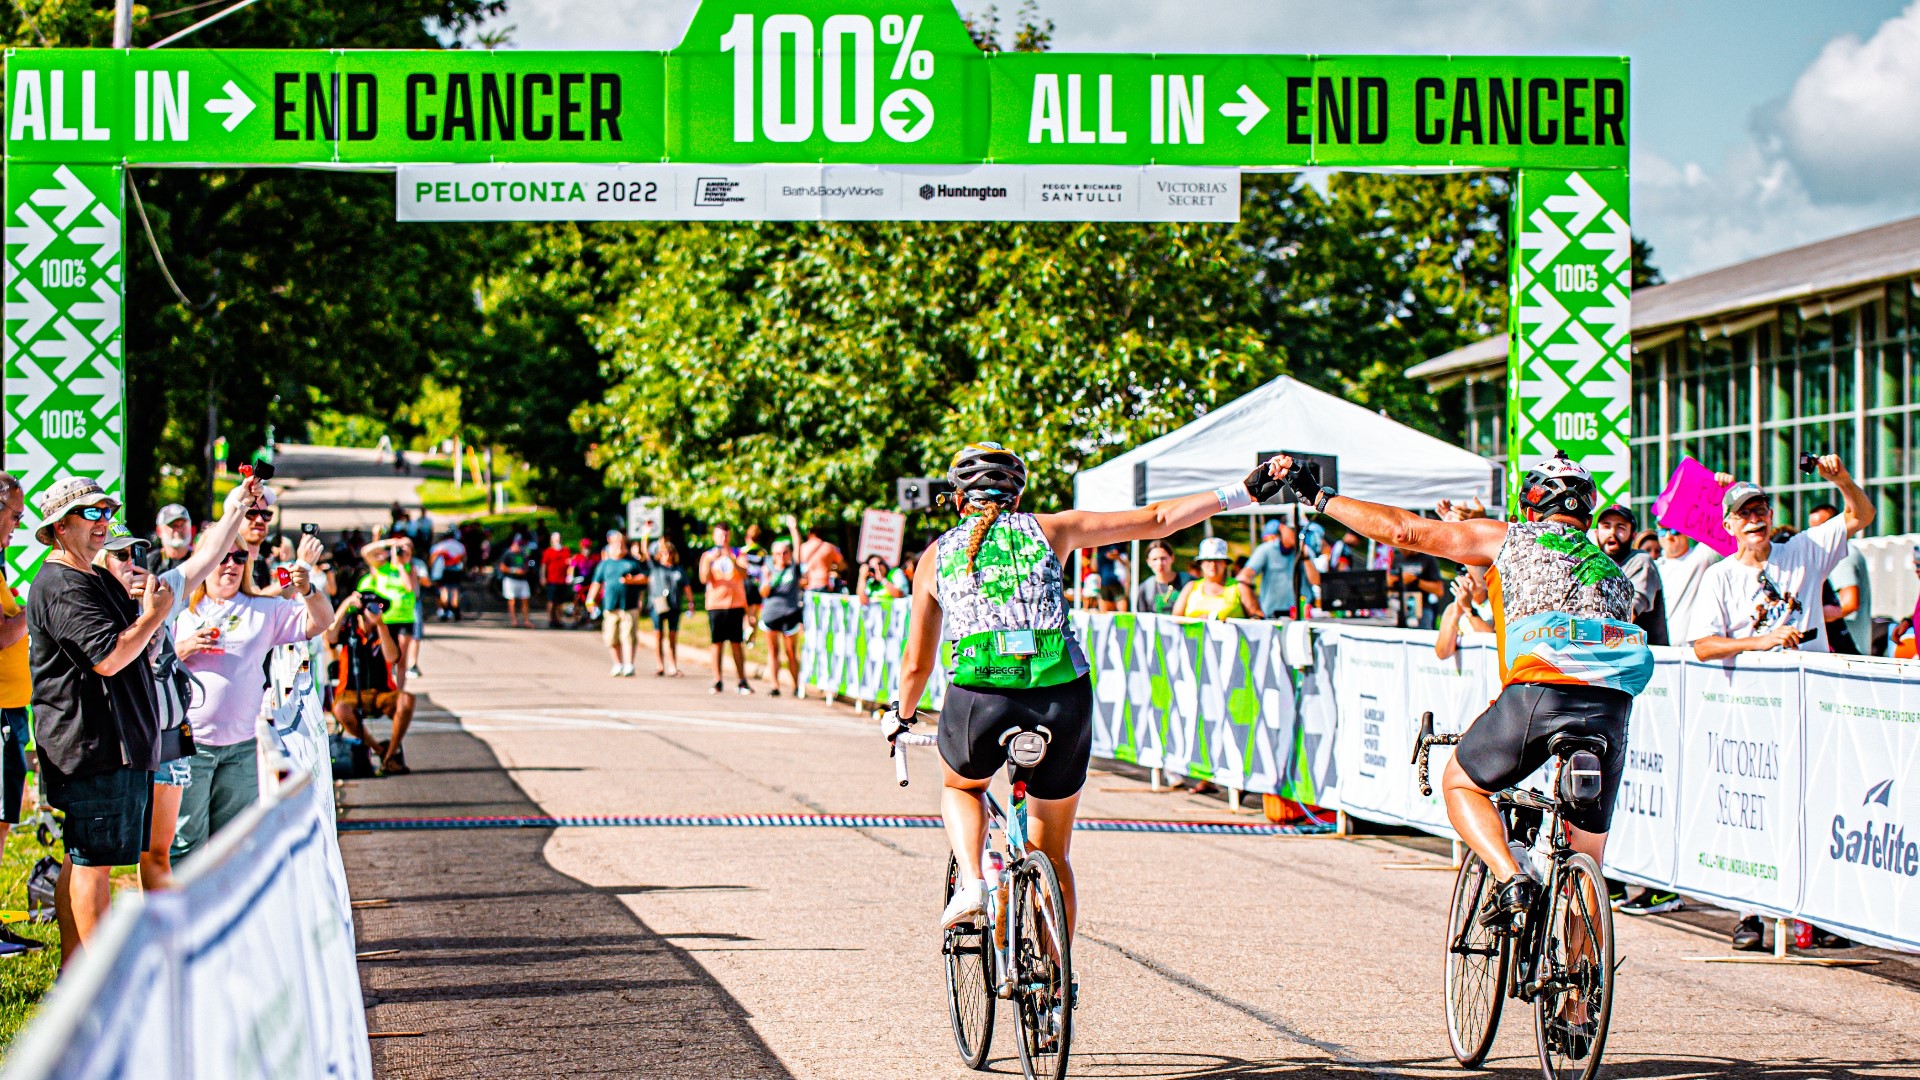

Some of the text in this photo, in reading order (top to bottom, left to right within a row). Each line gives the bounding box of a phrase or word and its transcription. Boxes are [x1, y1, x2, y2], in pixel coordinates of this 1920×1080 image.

[720, 14, 935, 143] 100%
[10, 69, 623, 142] ALL IN END CANCER
[1028, 73, 1626, 146] ALL IN END CANCER
[415, 181, 658, 202] PELOTONIA 2022
[937, 183, 1007, 201] Huntington
[1042, 192, 1122, 202] SANTULLI
[1157, 181, 1228, 193] VICTORIA'S
[1168, 195, 1216, 206] SECRET
[39, 259, 87, 288] 100%
[1553, 263, 1599, 293] 100%
[39, 409, 87, 439] 100%
[1553, 411, 1599, 441] 100%
[1522, 625, 1567, 642] one
[974, 666, 1025, 675] HABEGGER
[1708, 731, 1779, 781] VICTORIA'S
[1716, 783, 1766, 831] SECRET
[1830, 814, 1919, 877] Safelite
